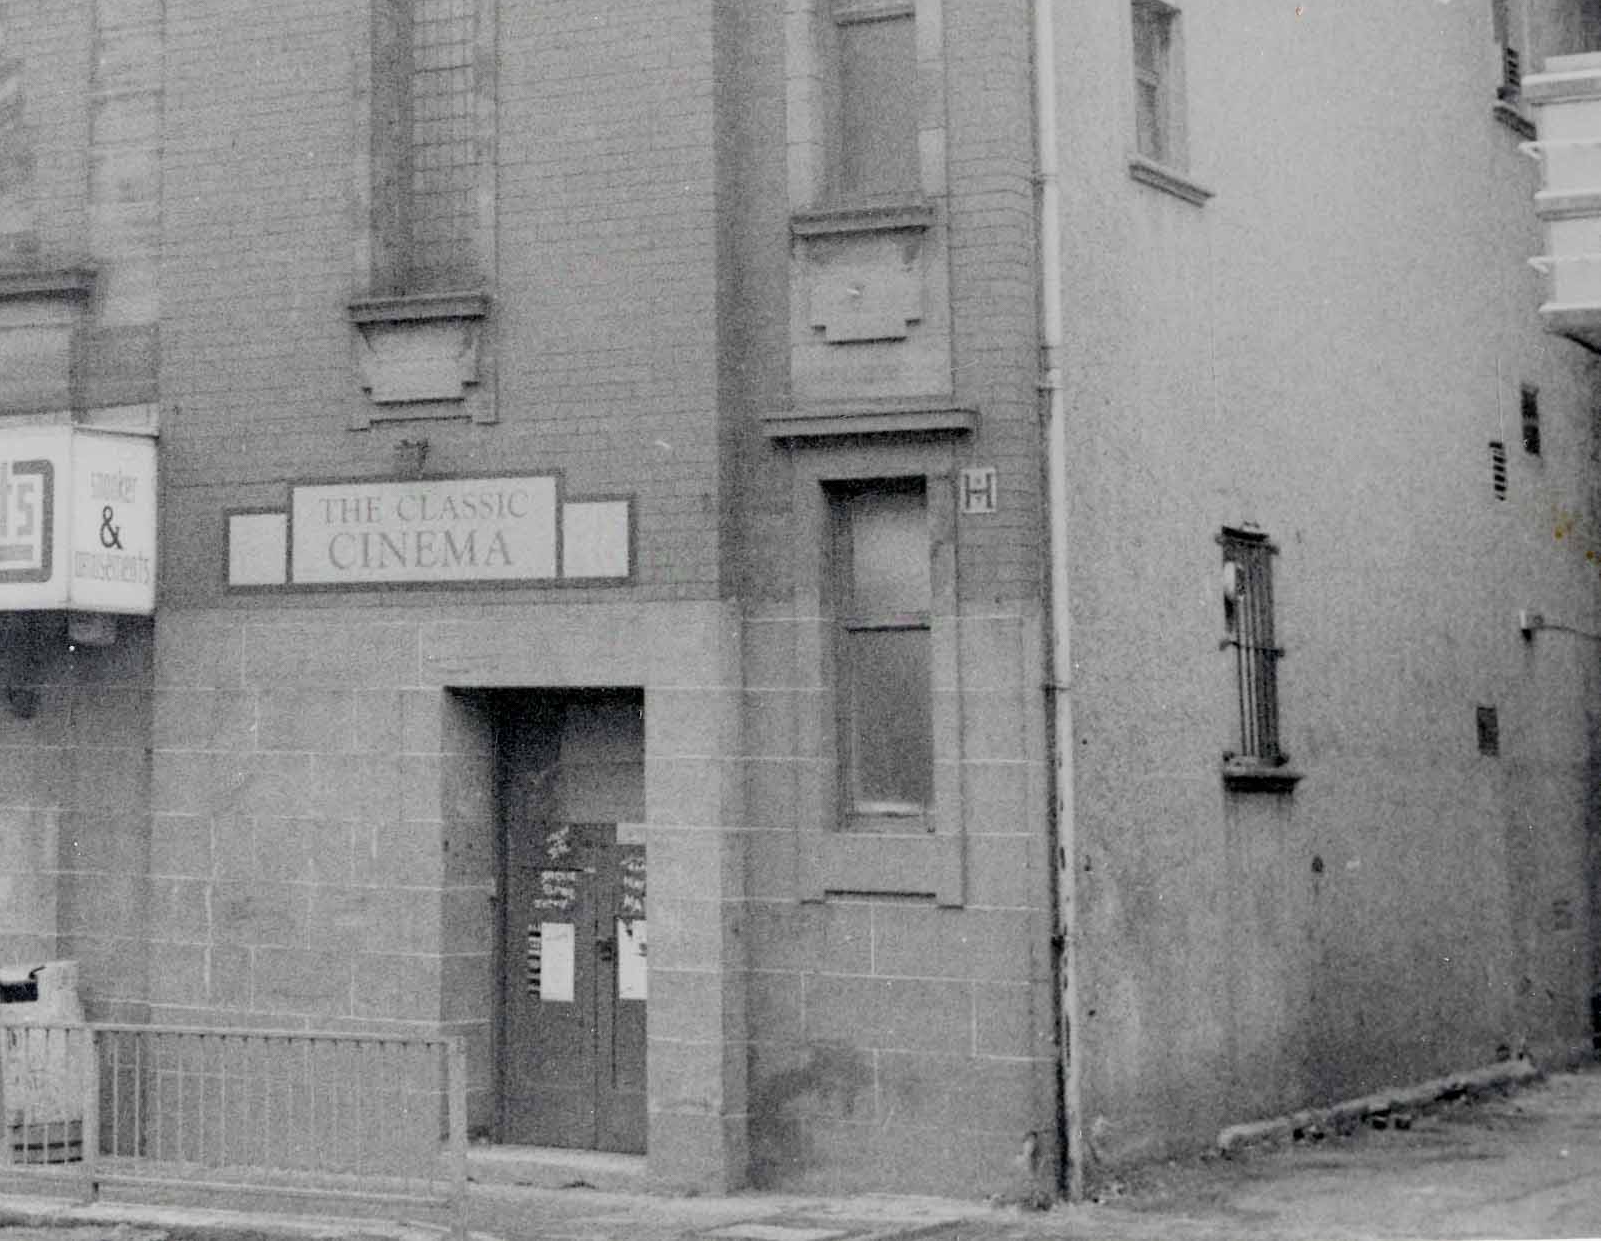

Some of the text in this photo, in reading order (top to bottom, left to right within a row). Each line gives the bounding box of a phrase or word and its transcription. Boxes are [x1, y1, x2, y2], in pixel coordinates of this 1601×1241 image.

[319, 490, 530, 525] THE CLASSIC
[964, 473, 993, 509] H
[99, 504, 124, 550] &
[327, 528, 515, 570] CINEMA
